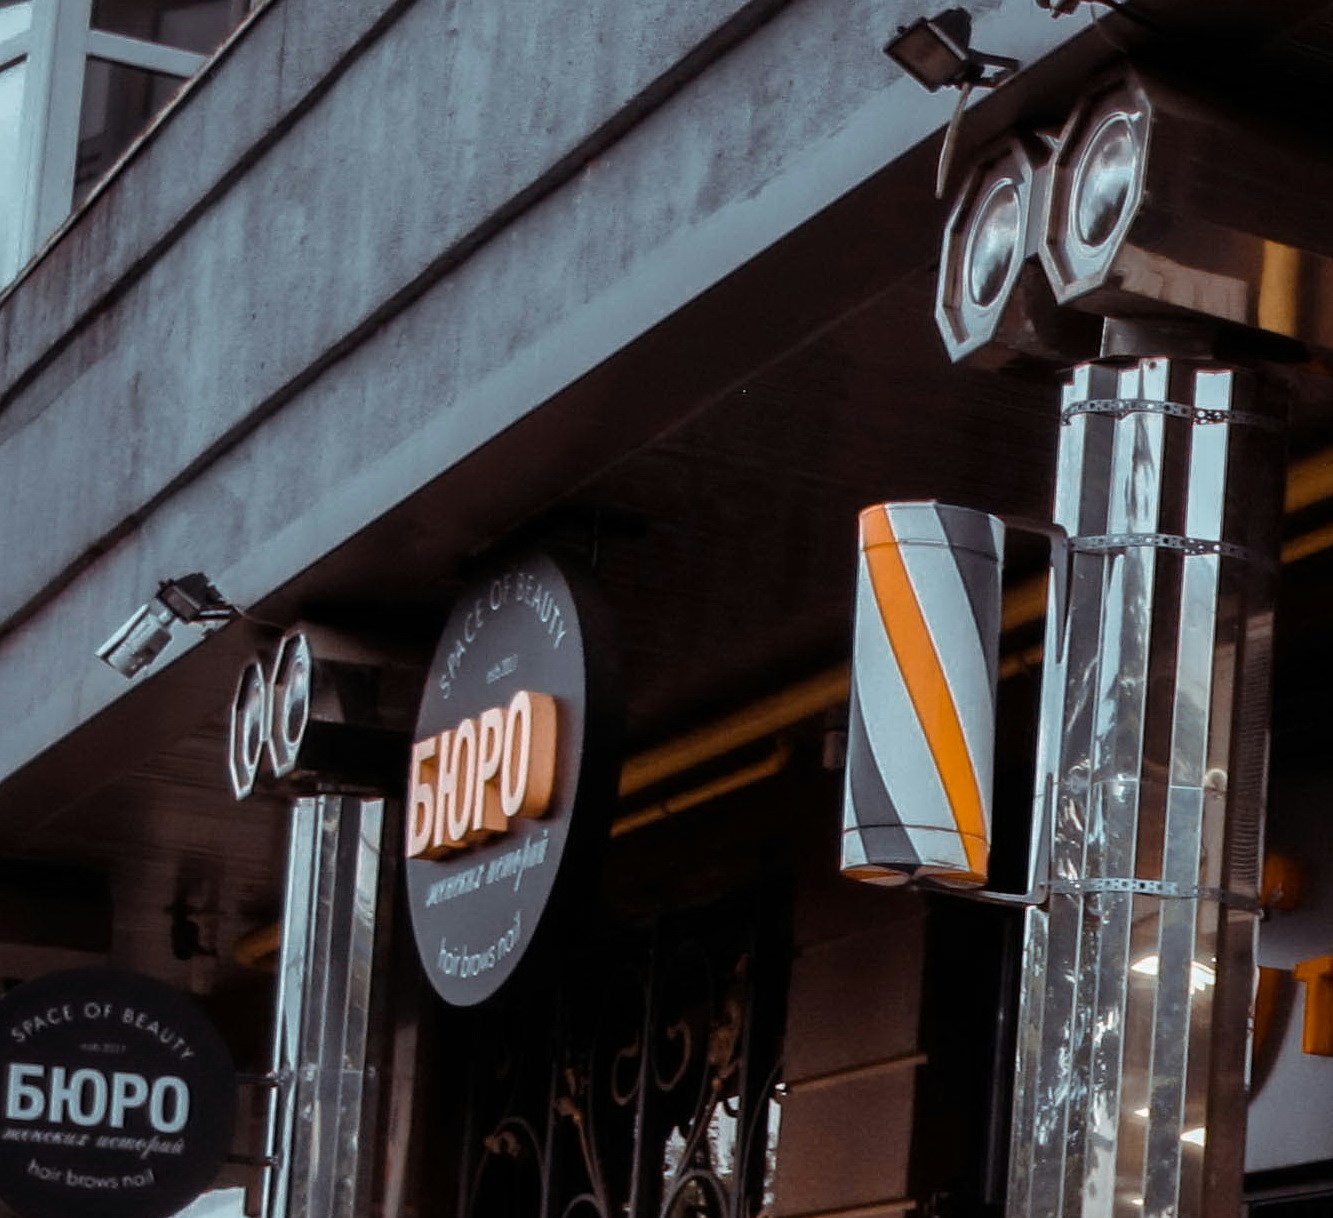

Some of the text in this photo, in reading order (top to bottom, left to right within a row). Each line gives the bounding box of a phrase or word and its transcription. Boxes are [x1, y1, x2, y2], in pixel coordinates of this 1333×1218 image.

[439, 598, 485, 699] SPACE
[515, 572, 567, 650] BEAUTY
[406, 689, 533, 859] БЮРО
[10, 1001, 196, 1061] SPACE OF BEAUTY
[5, 1061, 191, 1134] БЮРО
[26, 1157, 156, 1190] hair brows nail
